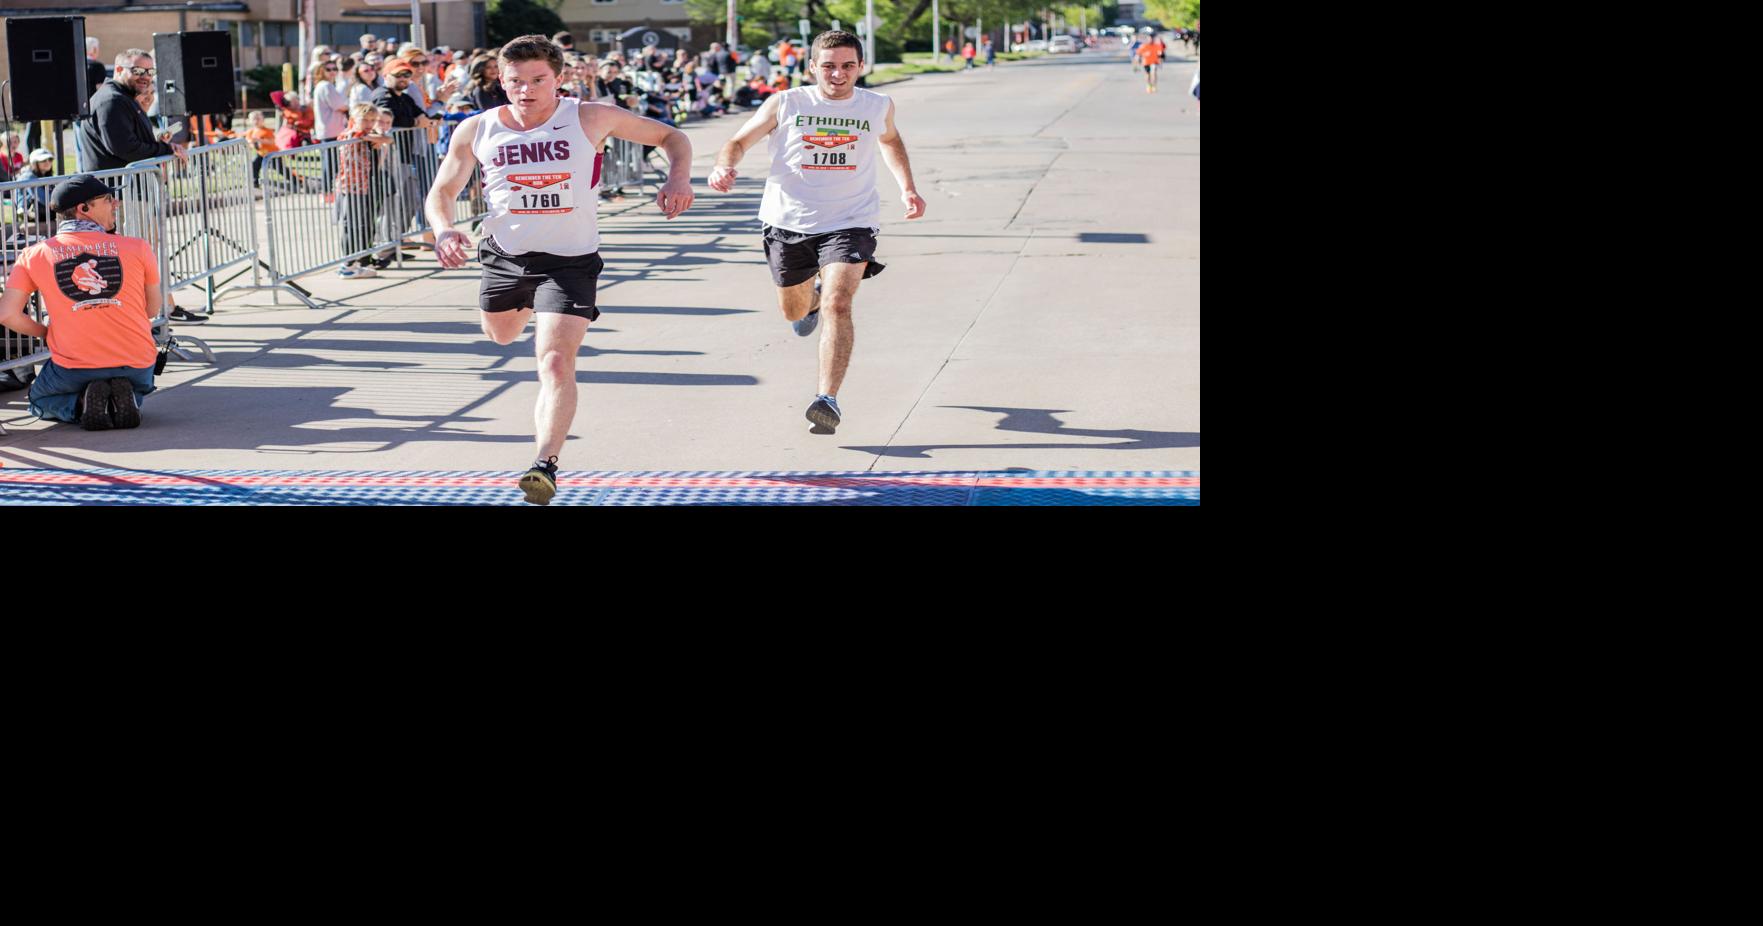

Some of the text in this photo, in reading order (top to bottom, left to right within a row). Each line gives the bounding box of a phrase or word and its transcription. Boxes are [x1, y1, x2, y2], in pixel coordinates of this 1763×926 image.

[795, 115, 870, 132] ETHIOPIA
[492, 140, 570, 167] JENKS
[813, 152, 846, 165] 1708
[521, 193, 560, 208] 1760
[52, 241, 117, 255] REMEMBER
[97, 249, 118, 257] TEN
